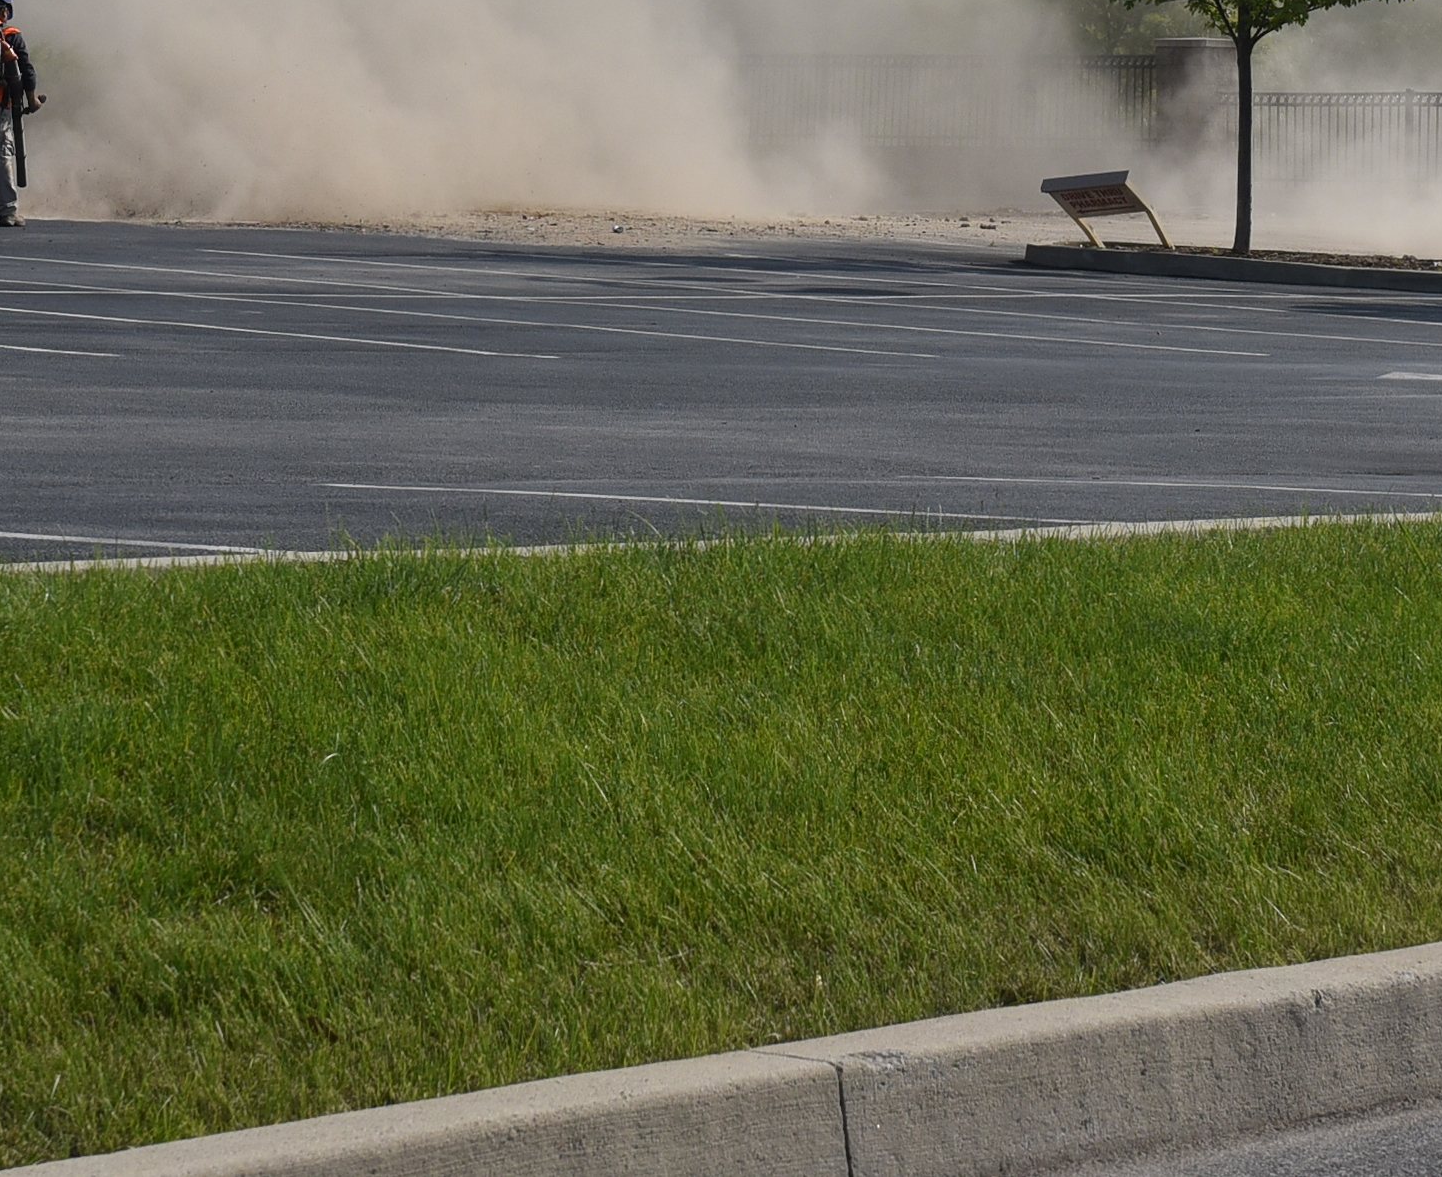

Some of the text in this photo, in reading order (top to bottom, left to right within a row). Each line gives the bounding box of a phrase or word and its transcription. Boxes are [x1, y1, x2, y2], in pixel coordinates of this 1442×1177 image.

[1060, 187, 1124, 201] DRIVE THRU
[1069, 195, 1128, 209] PHARMACY
